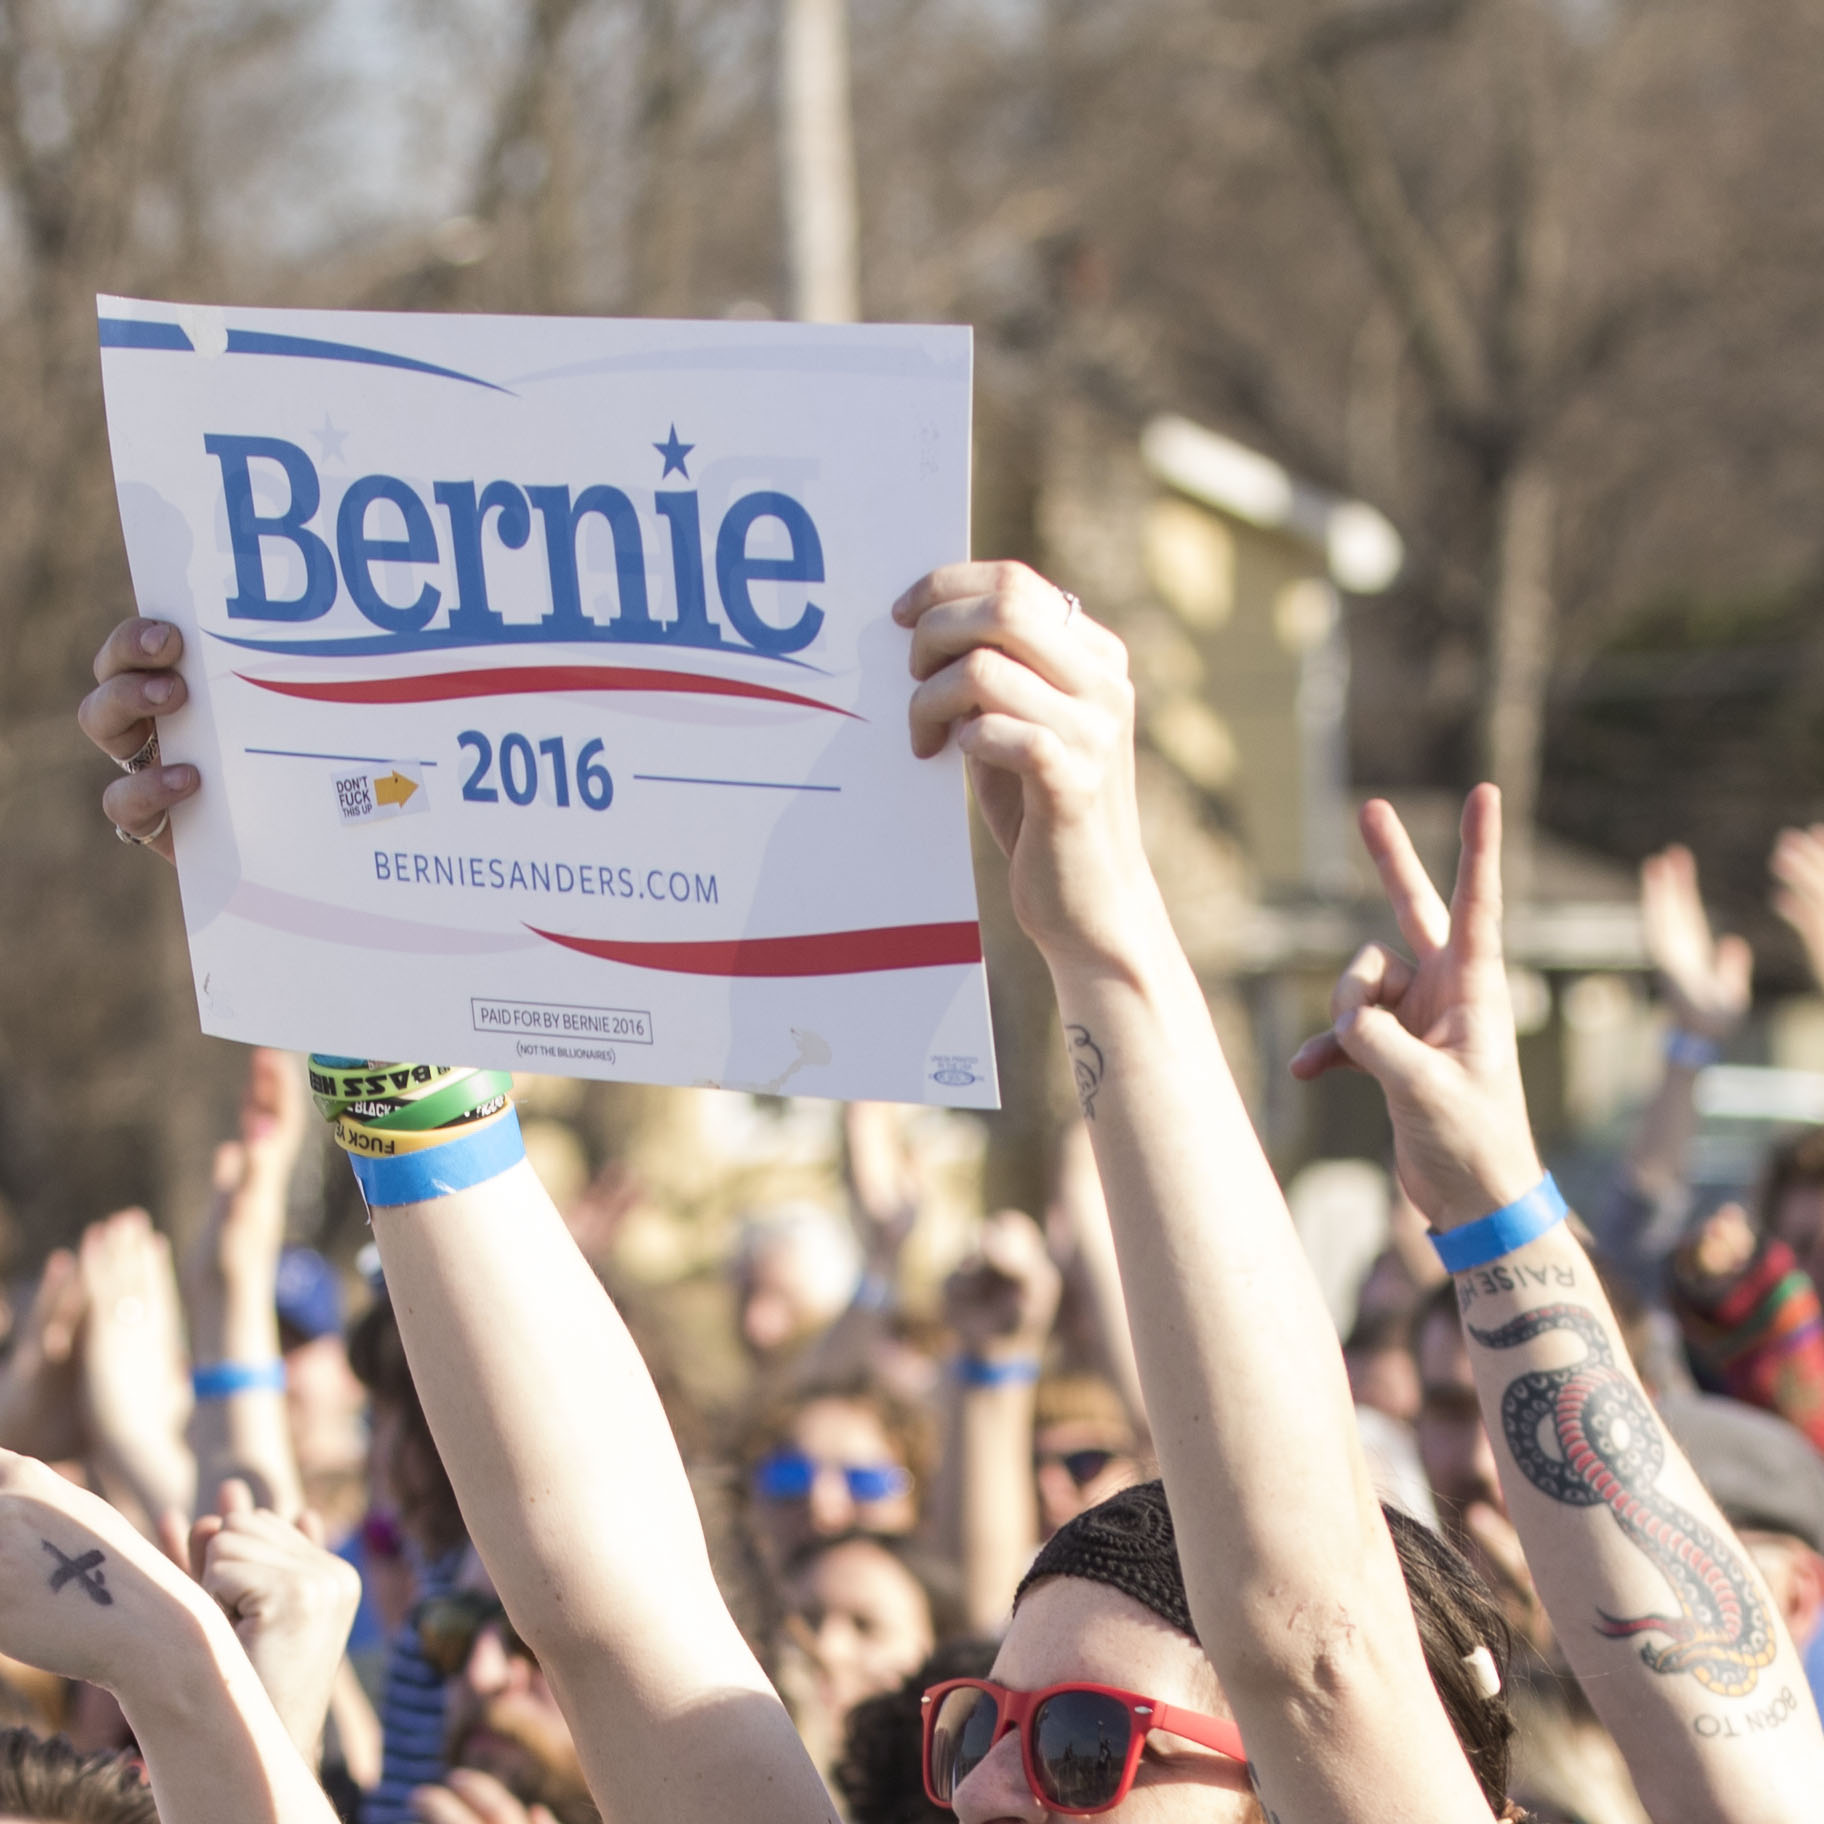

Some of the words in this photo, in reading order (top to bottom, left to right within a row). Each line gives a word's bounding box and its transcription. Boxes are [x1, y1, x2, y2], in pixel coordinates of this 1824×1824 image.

[203, 422, 825, 655] Bernie
[456, 729, 614, 811] 2016
[336, 776, 368, 794] DON'T
[339, 789, 371, 807] FUCK
[342, 806, 361, 818] THIS
[361, 803, 373, 815] UP
[374, 851, 719, 906] BERNIESANDERS.COM
[481, 1007, 511, 1025] PAID
[514, 1010, 541, 1027] FOR
[544, 1012, 560, 1029] BY
[563, 1014, 610, 1033] BERNIE
[613, 1017, 645, 1036] 2016
[516, 1040, 539, 1057] (NOT
[540, 1046, 556, 1058] THE
[557, 1047, 617, 1065] BILLIONAIRES)
[342, 1065, 432, 1097] BASS
[354, 1100, 391, 1118] BLACK
[348, 1129, 395, 1155] FUCK
[1476, 1264, 1575, 1295] RAISE
[1693, 1713, 1742, 1737] TO
